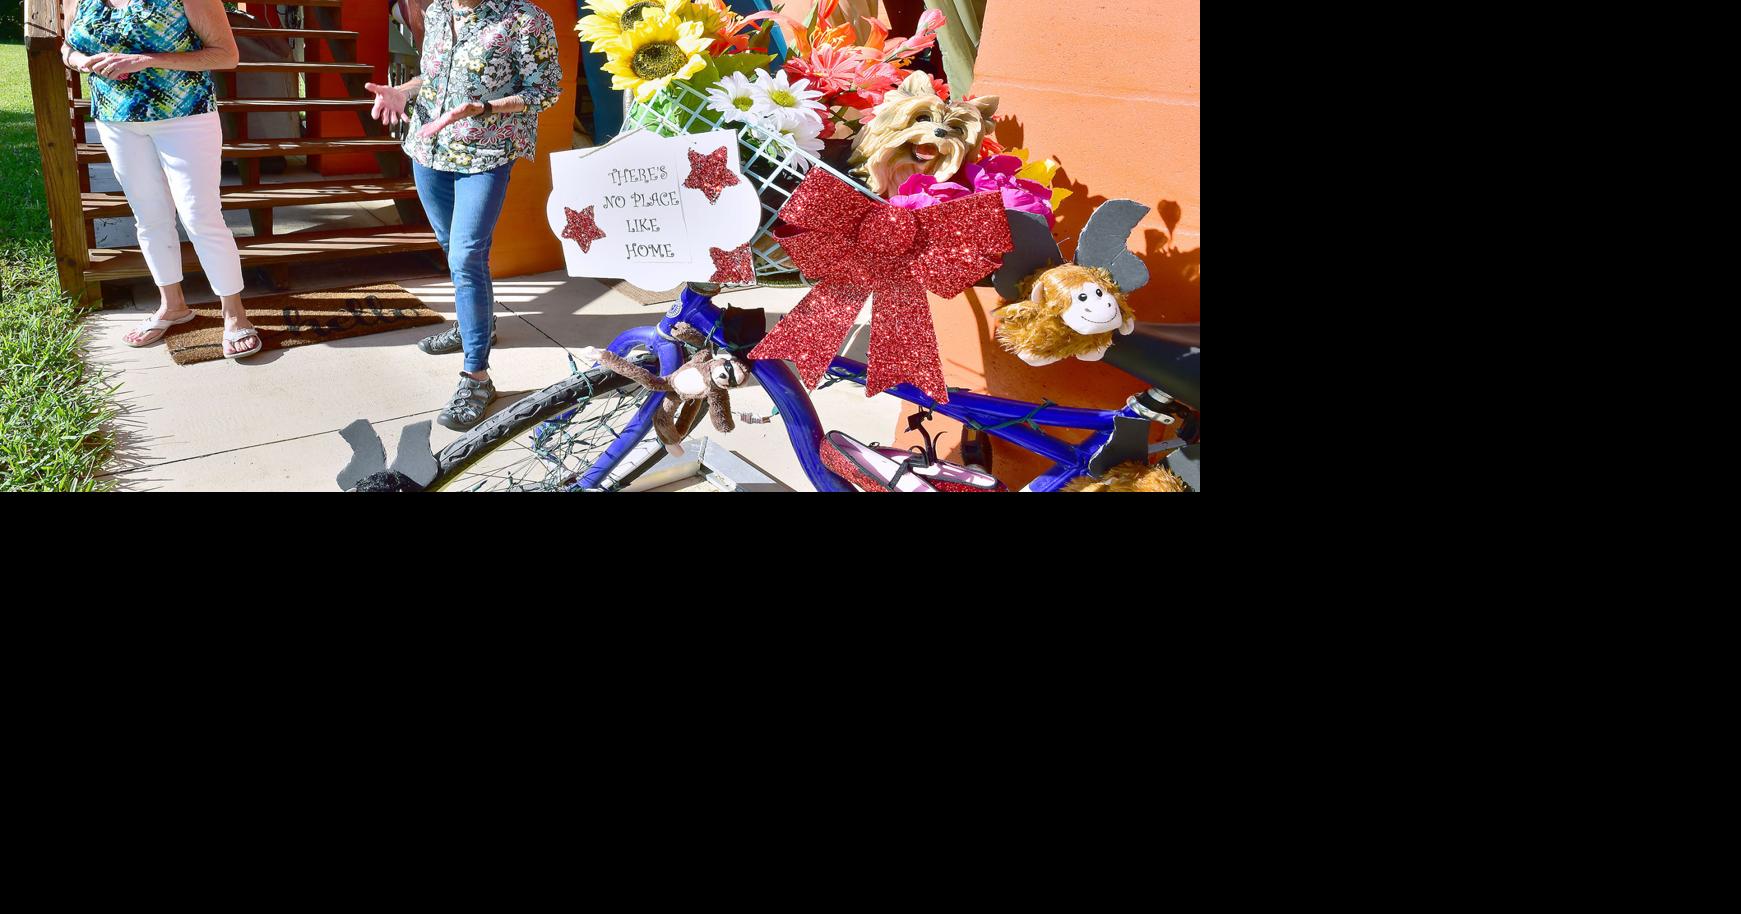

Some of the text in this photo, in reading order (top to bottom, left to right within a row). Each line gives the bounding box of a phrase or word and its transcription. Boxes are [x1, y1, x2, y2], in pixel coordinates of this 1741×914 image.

[608, 165, 668, 186] THERE'S
[603, 191, 680, 209] NO PLACE
[626, 218, 660, 233] LIKE
[625, 243, 675, 259] HOME
[282, 295, 420, 336] hello
